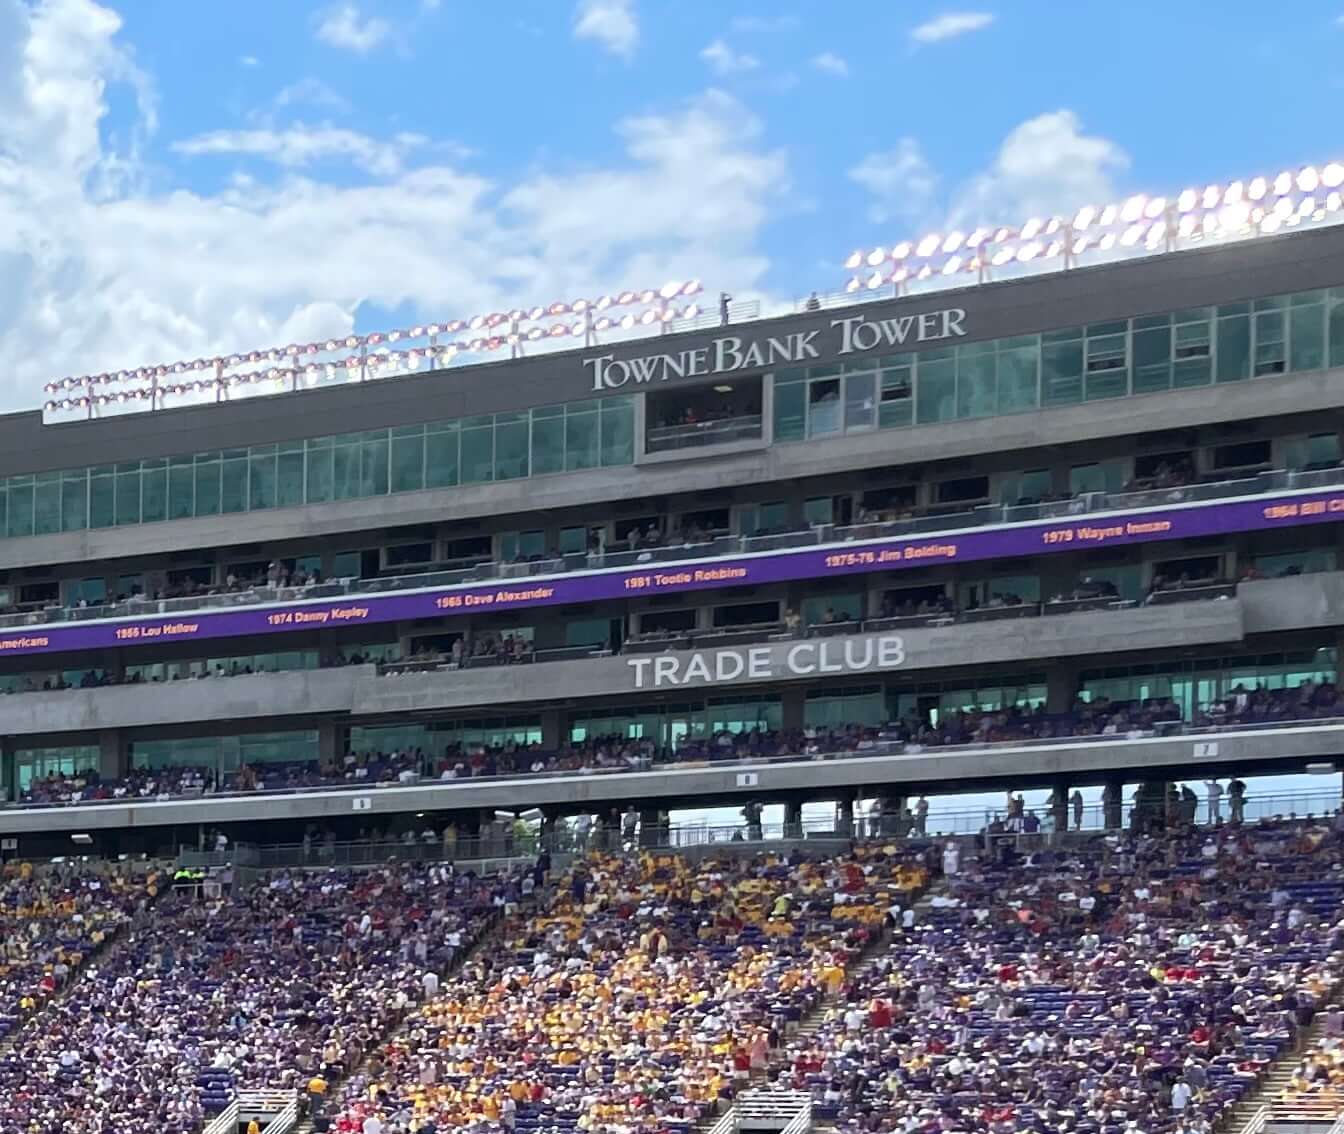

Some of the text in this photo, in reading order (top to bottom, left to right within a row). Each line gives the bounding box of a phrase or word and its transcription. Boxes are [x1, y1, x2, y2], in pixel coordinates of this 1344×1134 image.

[831, 308, 968, 355] TOWER
[877, 550, 901, 563] Jim
[495, 586, 554, 603] Alexander
[627, 636, 906, 688] TRADE CLUB
